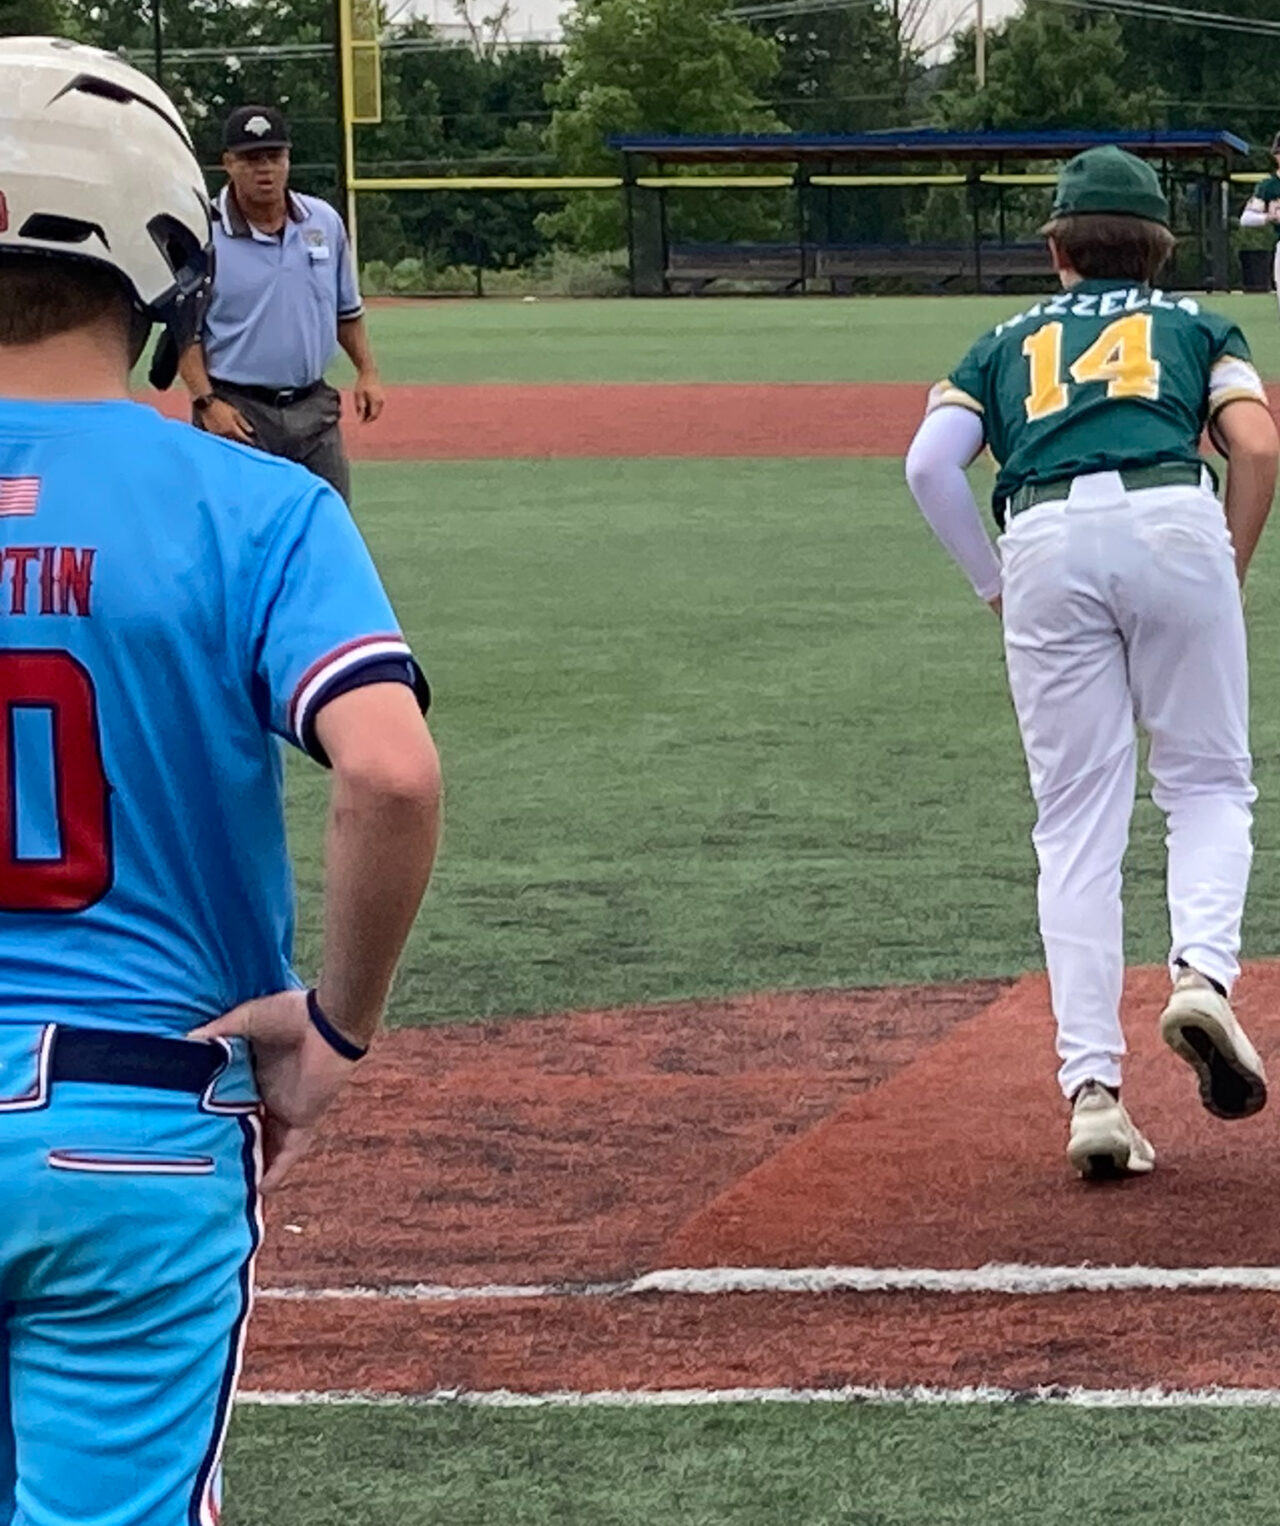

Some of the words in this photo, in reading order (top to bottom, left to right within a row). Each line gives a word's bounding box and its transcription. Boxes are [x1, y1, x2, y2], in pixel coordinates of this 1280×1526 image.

[995, 289, 1200, 336] ZZELL
[1022, 312, 1161, 423] 14
[0, 546, 97, 617] TIN
